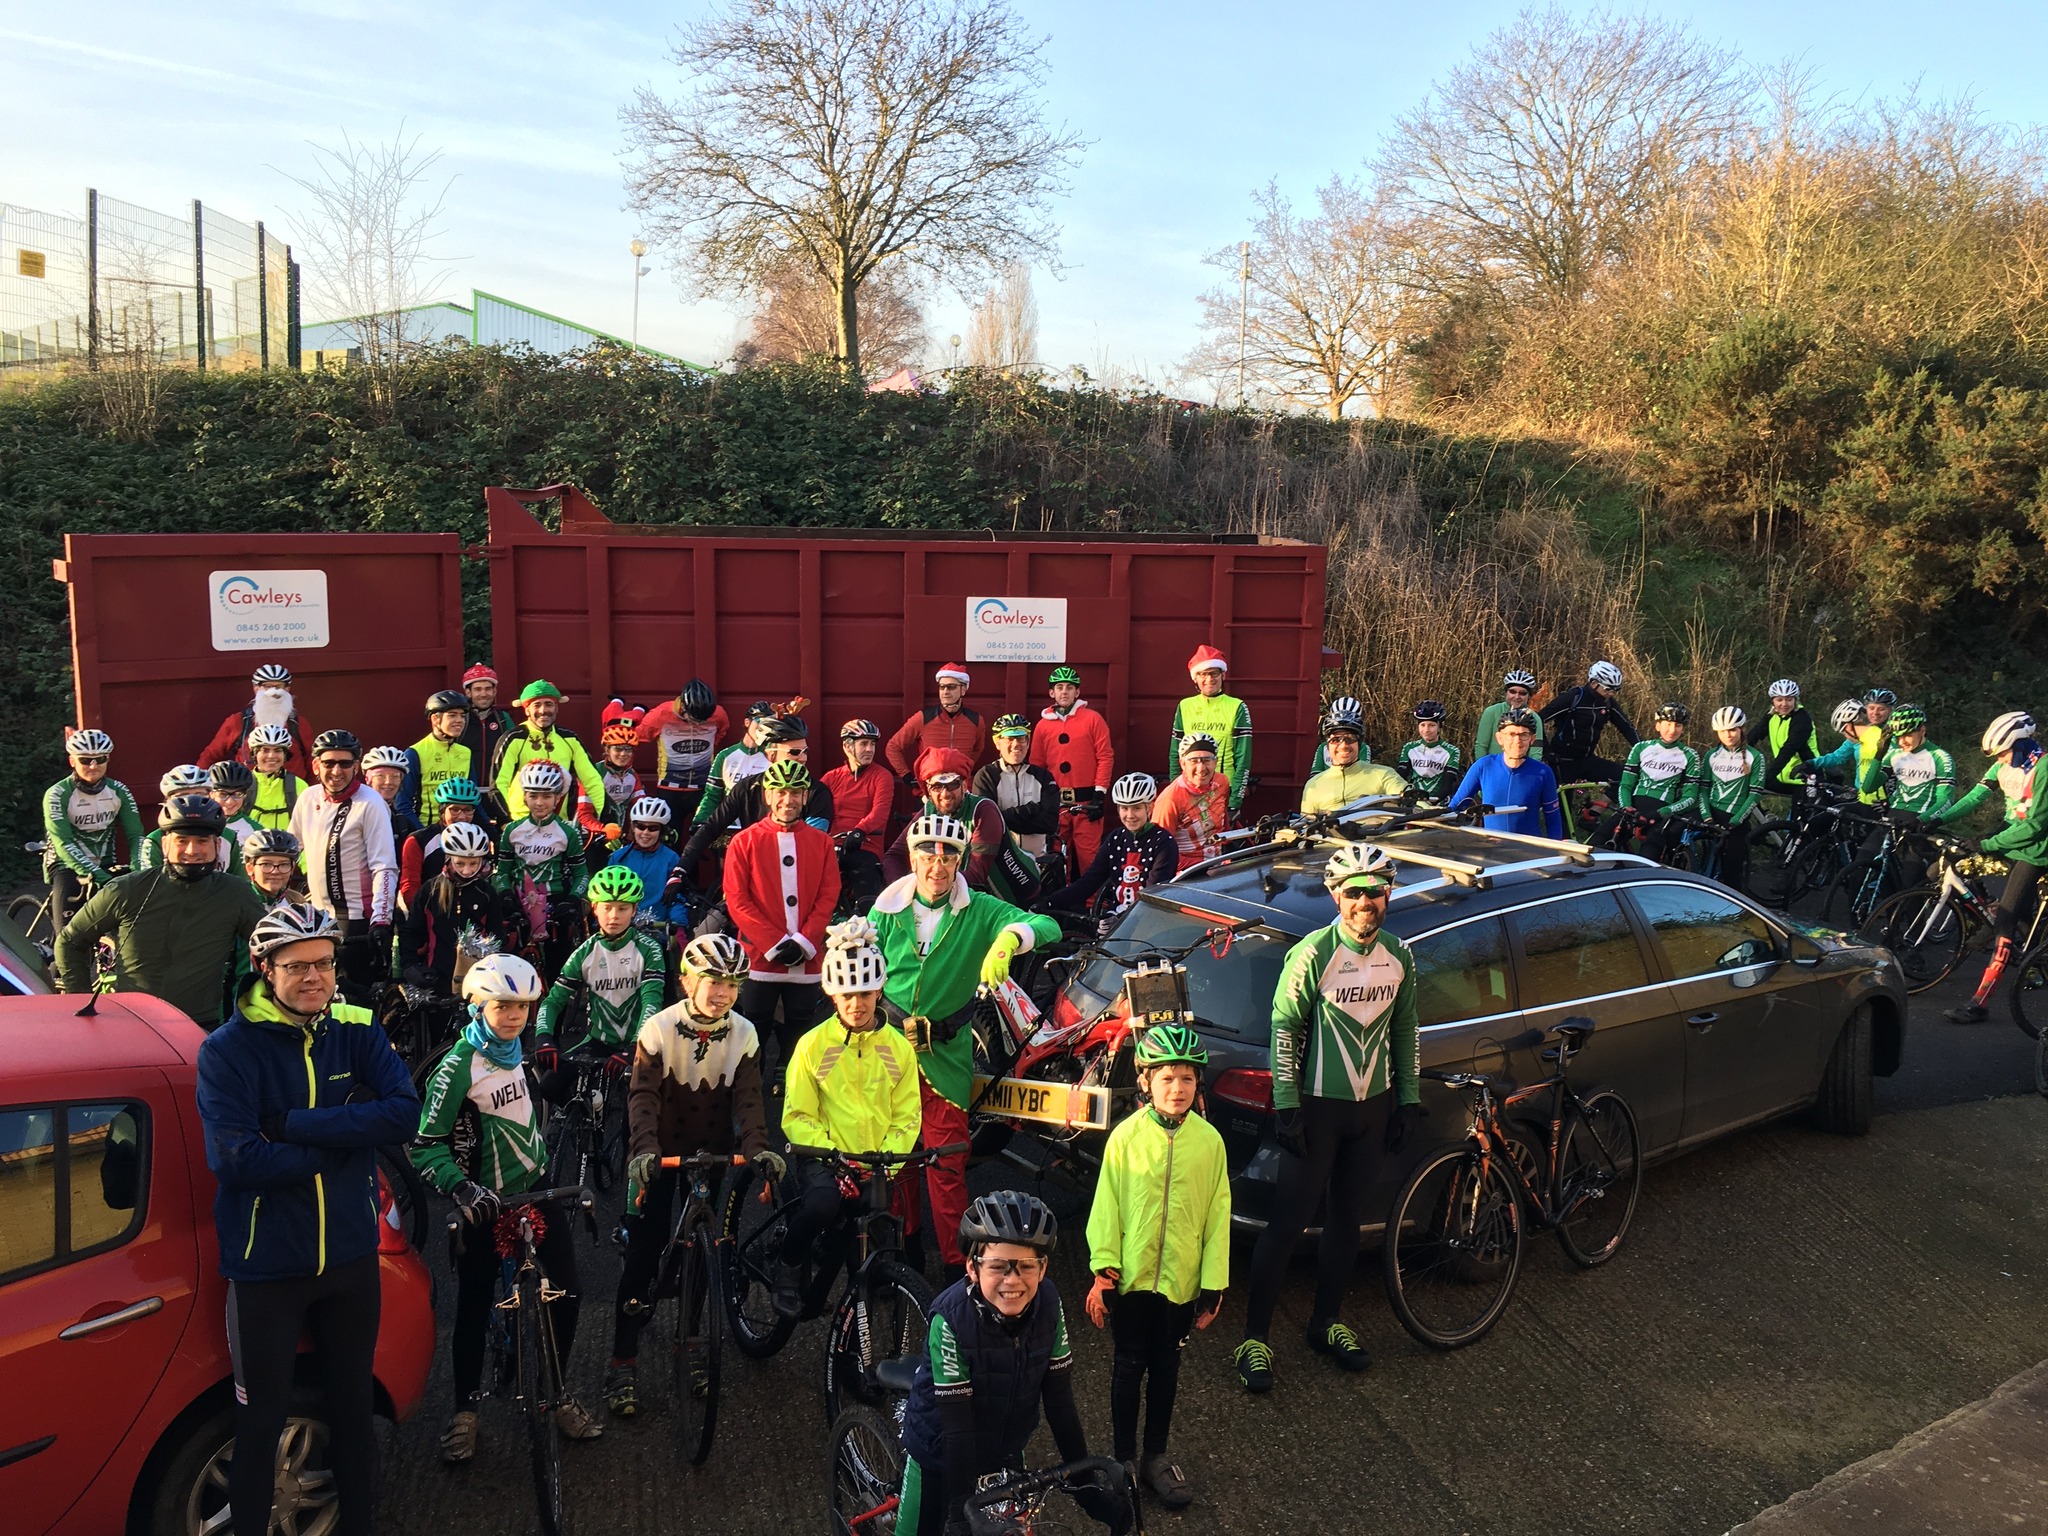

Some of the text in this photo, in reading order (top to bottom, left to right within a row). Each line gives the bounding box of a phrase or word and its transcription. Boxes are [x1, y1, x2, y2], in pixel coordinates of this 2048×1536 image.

[227, 587, 303, 608] Cawleys
[236, 622, 306, 632] 0845 260 2000
[981, 609, 1044, 629] Cawleys
[223, 633, 320, 644] www.cawleys.co.uk
[986, 642, 1047, 650] 0845 260 2000
[975, 652, 1057, 661] www.cawleys.co.uk
[1191, 721, 1226, 732] WELWYN
[1412, 758, 1445, 772] WELWYN
[74, 810, 117, 825] WELWYN
[329, 832, 338, 867] LONDON
[1003, 848, 1030, 885] WELWYN
[330, 867, 341, 900] CENTRAL
[1285, 943, 1319, 1002] WELWYN
[595, 976, 638, 992] WELWYN
[1335, 984, 1396, 1004] WELWYN
[1276, 1028, 1294, 1082] WELWYN
[426, 1053, 463, 1125] WELWYN
[490, 1077, 530, 1111] WELW
[1017, 1086, 1051, 1114] YBC
